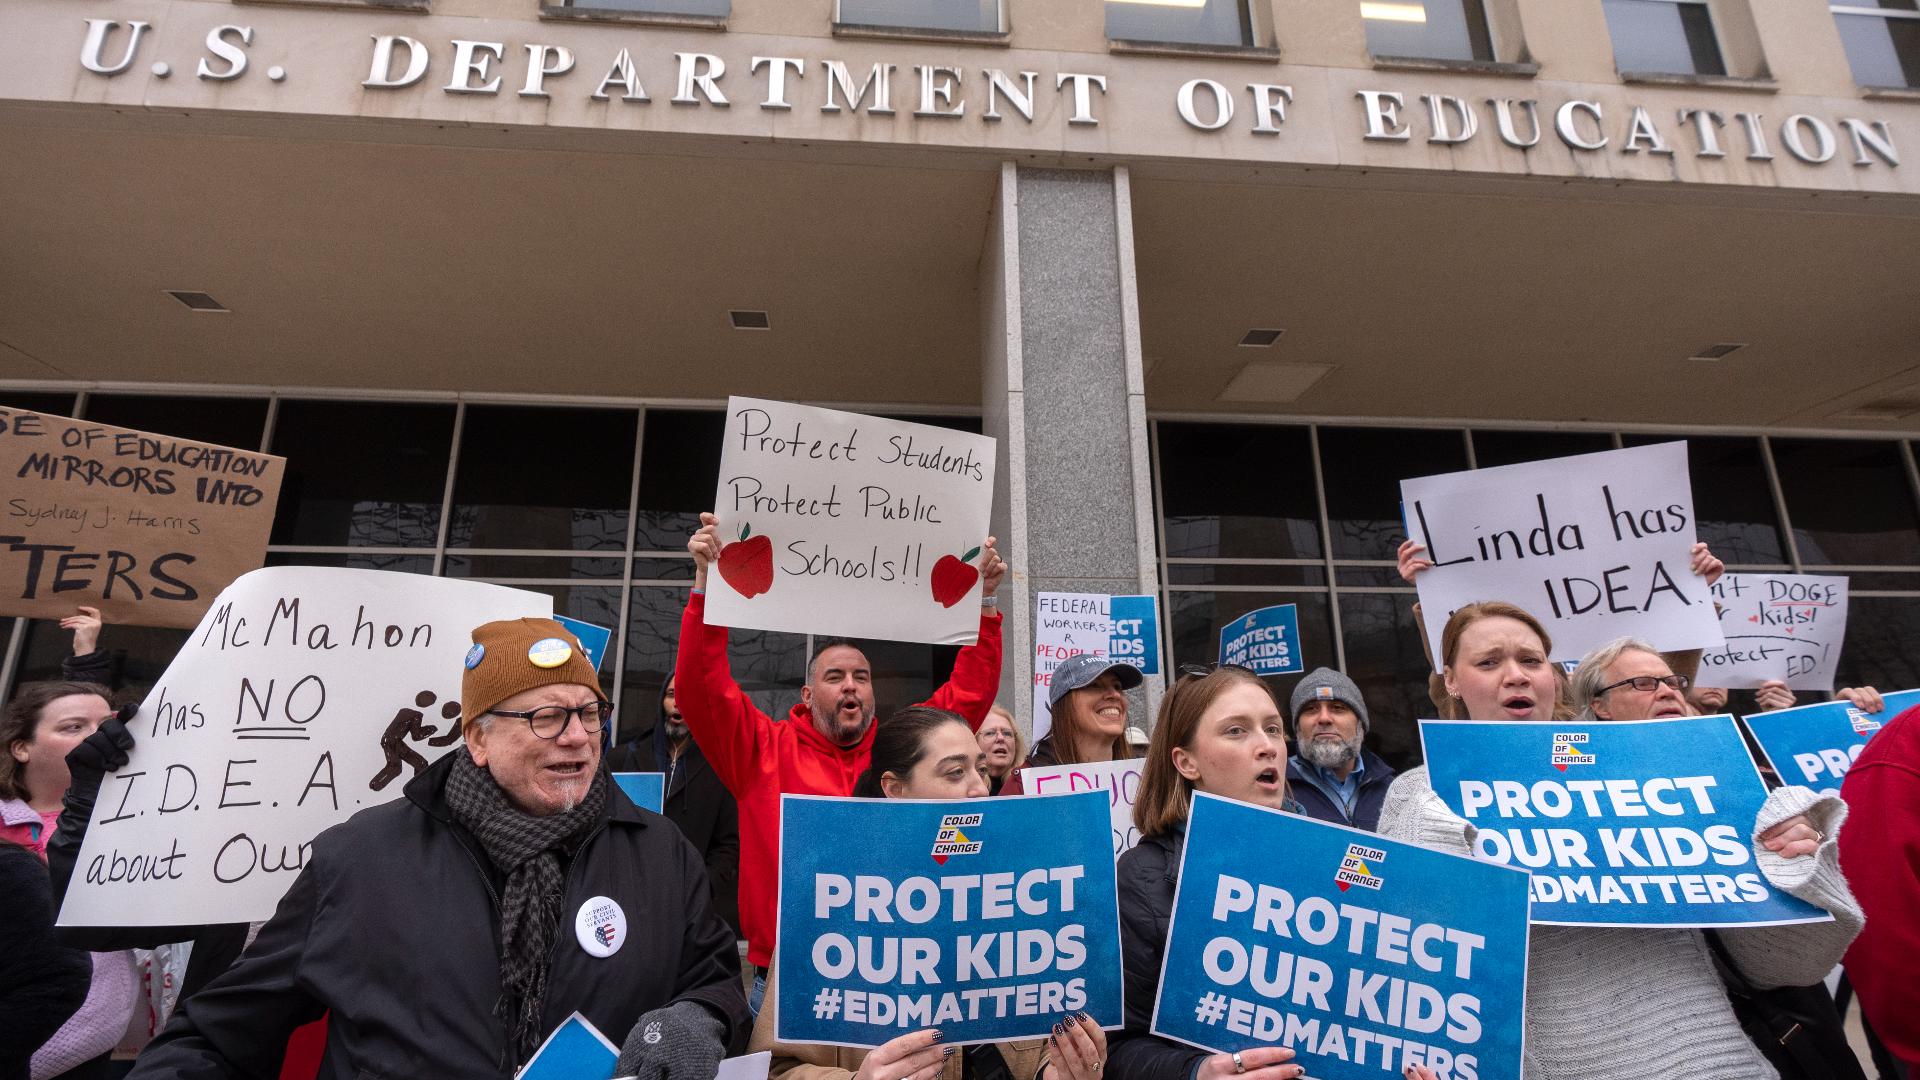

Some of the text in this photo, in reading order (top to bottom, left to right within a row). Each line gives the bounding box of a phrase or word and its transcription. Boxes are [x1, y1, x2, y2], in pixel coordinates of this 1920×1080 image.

[80, 19, 1899, 168] U.S. DEPARTMENT OF EDUCATION
[62, 427, 108, 449] OF
[115, 433, 269, 477] EDUCATION
[736, 408, 983, 481] Protect Students
[17, 452, 263, 507] MIRRORS INTO
[728, 476, 941, 523] Protect Public
[127, 508, 201, 535] Harris
[1414, 485, 1686, 567] Linda has
[0, 535, 199, 600] TERS
[781, 540, 923, 587] Schools!!
[1040, 598, 1110, 616] FEDERAL
[1764, 580, 1838, 606] DOGE
[1044, 619, 1106, 632] WORKERS
[1064, 633, 1075, 645] R
[1109, 638, 1145, 655] IDS
[1226, 625, 1286, 656] PROTECT
[1249, 641, 1289, 659] KIDS
[151, 674, 327, 738] has NO
[1556, 734, 1587, 742] COLOR
[1459, 775, 1717, 819] PROTECT
[939, 830, 955, 840] OF
[944, 815, 980, 826] COLOR
[86, 832, 313, 884] about Our
[934, 843, 980, 854] CHANGE
[1344, 858, 1359, 868] OF
[1349, 845, 1384, 861] COLOR
[1474, 824, 1751, 868] OUR KIDS
[815, 864, 1085, 924] PROTECT
[1338, 871, 1381, 888] CHANGE
[1531, 872, 1770, 905] DMATTERS
[1212, 873, 1486, 980] PROTECT
[811, 924, 1087, 986] OUR KIDS
[812, 977, 1087, 1028] #EDMATTERS
[1202, 936, 1483, 1044] OUR KIDS
[1194, 990, 1479, 1080] #EDMATTERS
